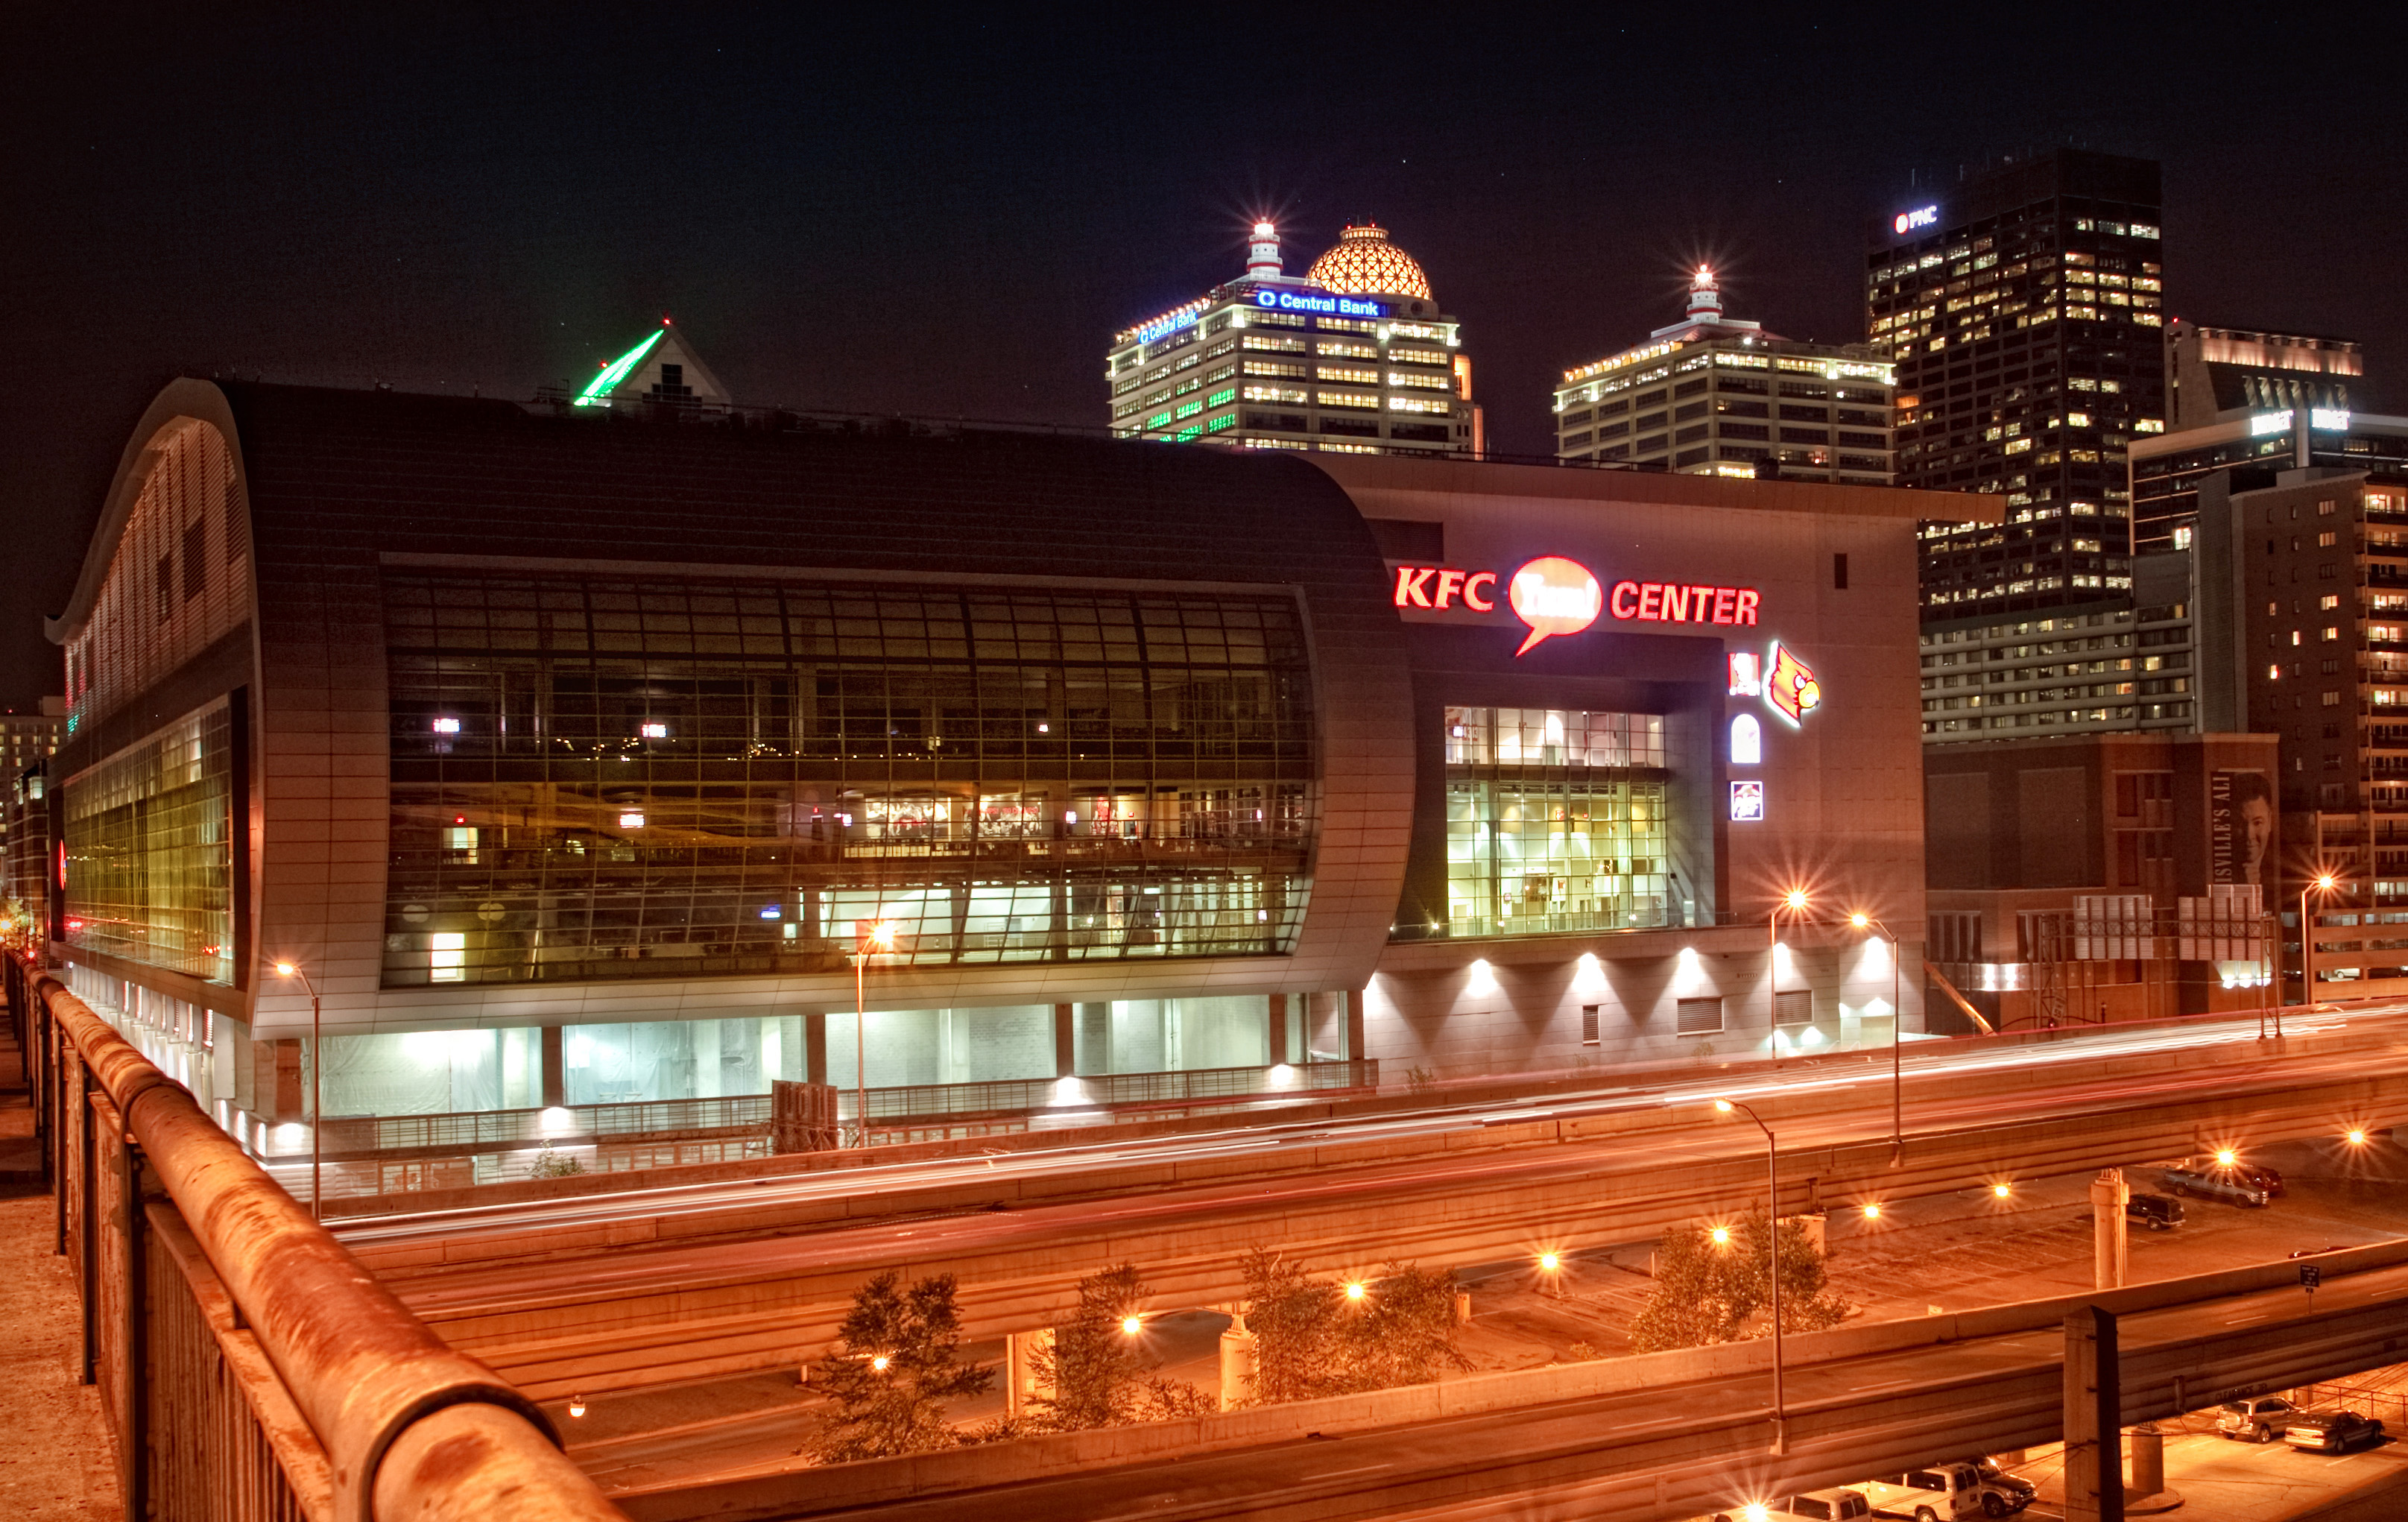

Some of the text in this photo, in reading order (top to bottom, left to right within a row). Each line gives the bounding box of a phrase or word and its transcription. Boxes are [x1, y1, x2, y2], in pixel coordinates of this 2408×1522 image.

[1909, 206, 1937, 228] PNC
[1280, 294, 1379, 316] Central Bank
[1149, 309, 1197, 340] Central Bank
[1394, 566, 1497, 611] KFC
[1611, 580, 1760, 626] CENTER
[2212, 777, 2231, 801] ALI
